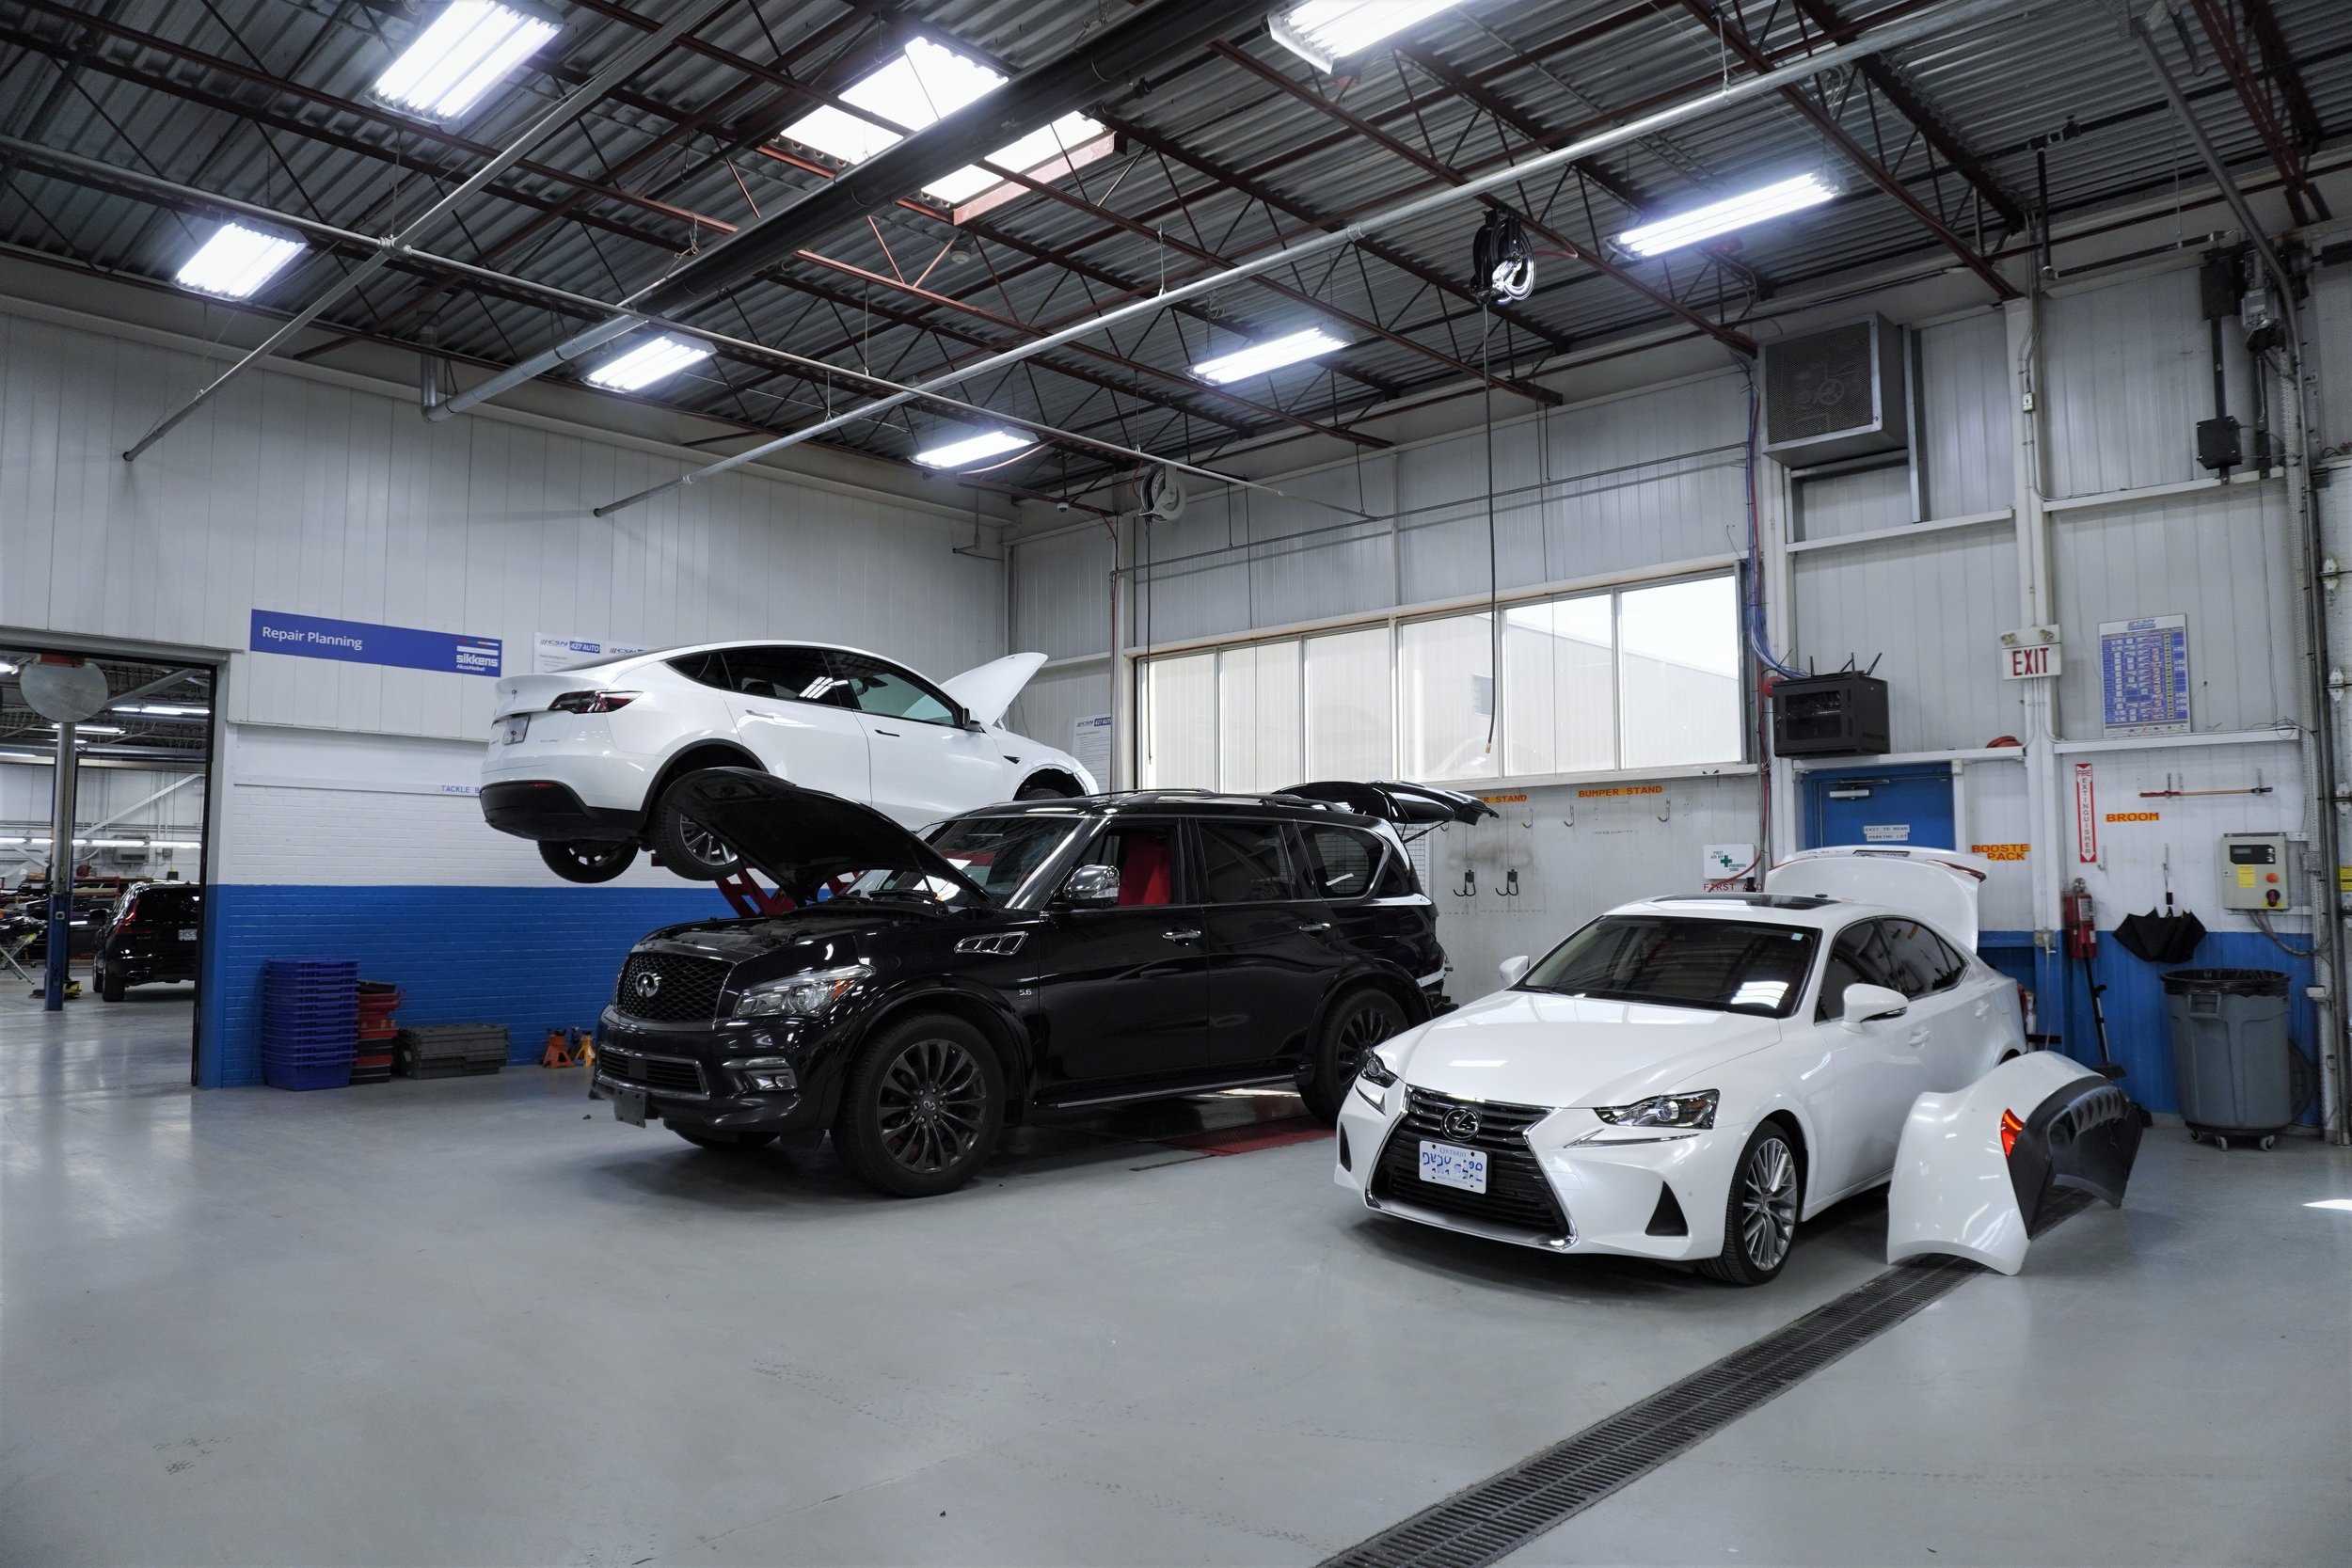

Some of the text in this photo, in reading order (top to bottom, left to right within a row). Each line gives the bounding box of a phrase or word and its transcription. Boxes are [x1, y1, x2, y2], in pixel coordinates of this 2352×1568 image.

[262, 626, 362, 651] Repair Planning
[582, 643, 599, 652] AUTO
[456, 654, 499, 667] sikkens
[2012, 647, 2049, 676] EXIT
[1579, 785, 1662, 798] BUMPER STAND
[1496, 795, 1527, 803] STAND
[2081, 777, 2091, 854] EXTINGUISHER
[2106, 812, 2159, 822] BROOM
[1971, 844, 2030, 852] BOOSTE
[1987, 852, 2026, 861] PACK
[1743, 882, 1762, 891] AD
